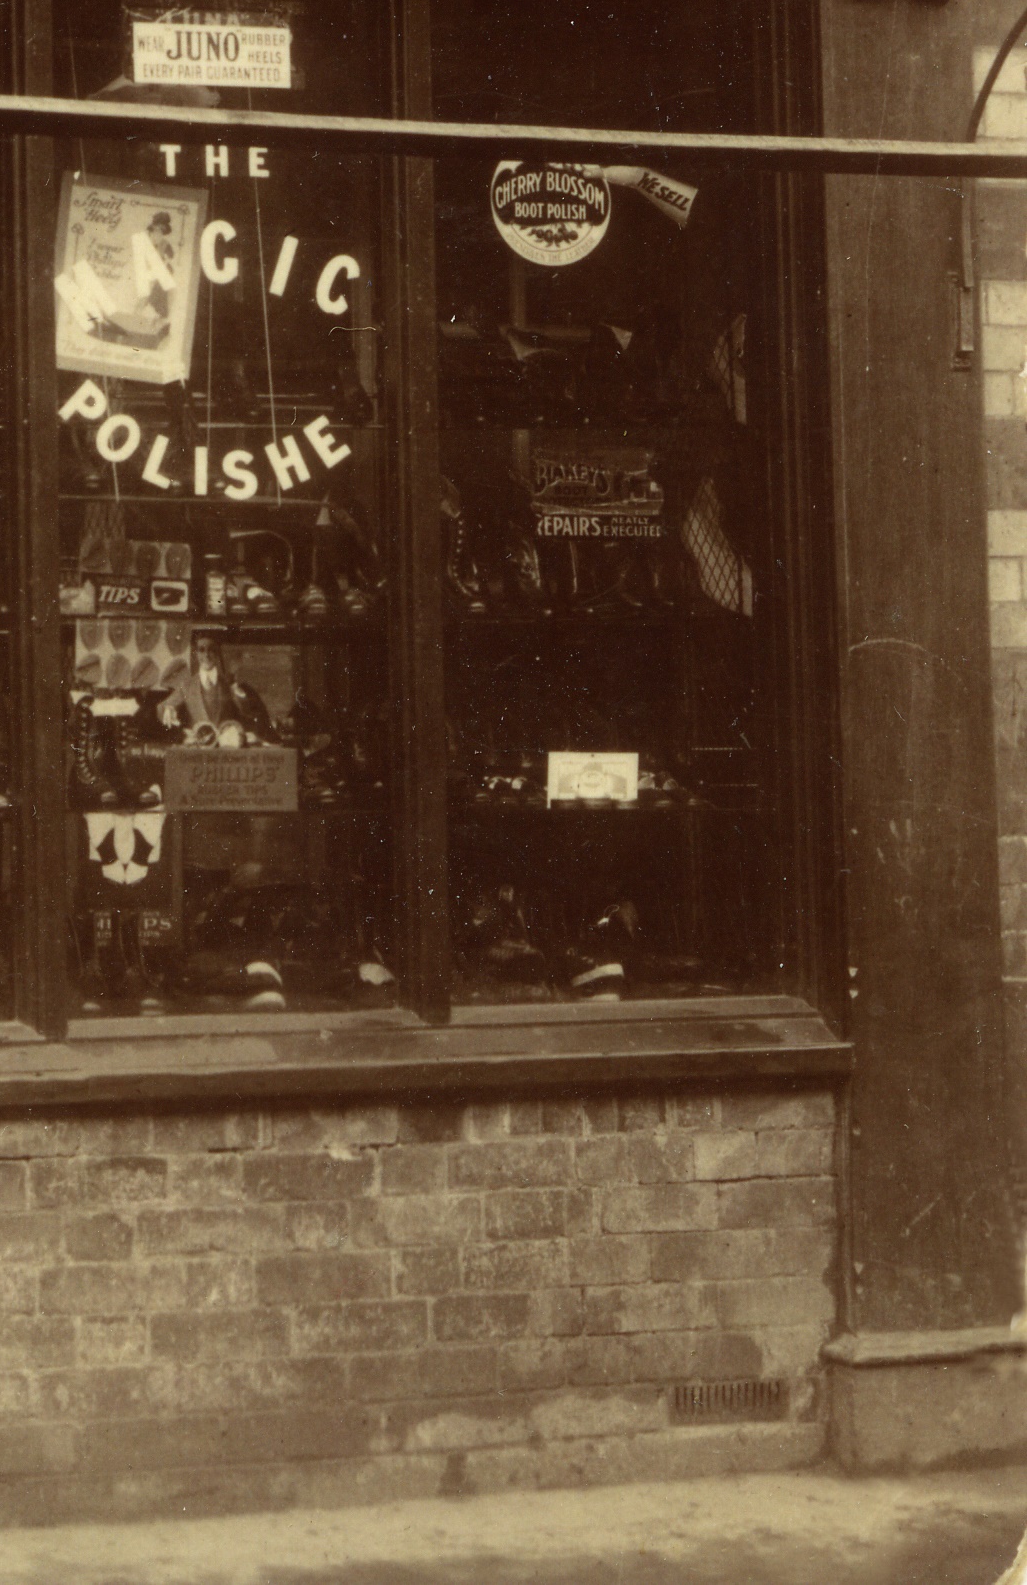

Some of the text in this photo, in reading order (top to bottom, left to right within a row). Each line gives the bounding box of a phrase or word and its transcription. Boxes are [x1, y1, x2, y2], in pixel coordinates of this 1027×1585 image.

[137, 35, 164, 52] WEAR
[241, 33, 286, 46] RUBBER
[248, 51, 282, 64] HEELS
[143, 64, 281, 82] EVERY PAIR GUARANTEED
[159, 143, 270, 178] THE
[73, 191, 126, 211] Smart
[495, 171, 605, 215] CHERRY BLOSSOM
[637, 172, 691, 211] WE SELL
[514, 203, 587, 220] BOOT POLISH
[54, 219, 360, 332] MAGIC
[58, 378, 352, 501] POLISHE
[611, 517, 649, 525] NEATLY
[98, 585, 141, 604] TIPS
